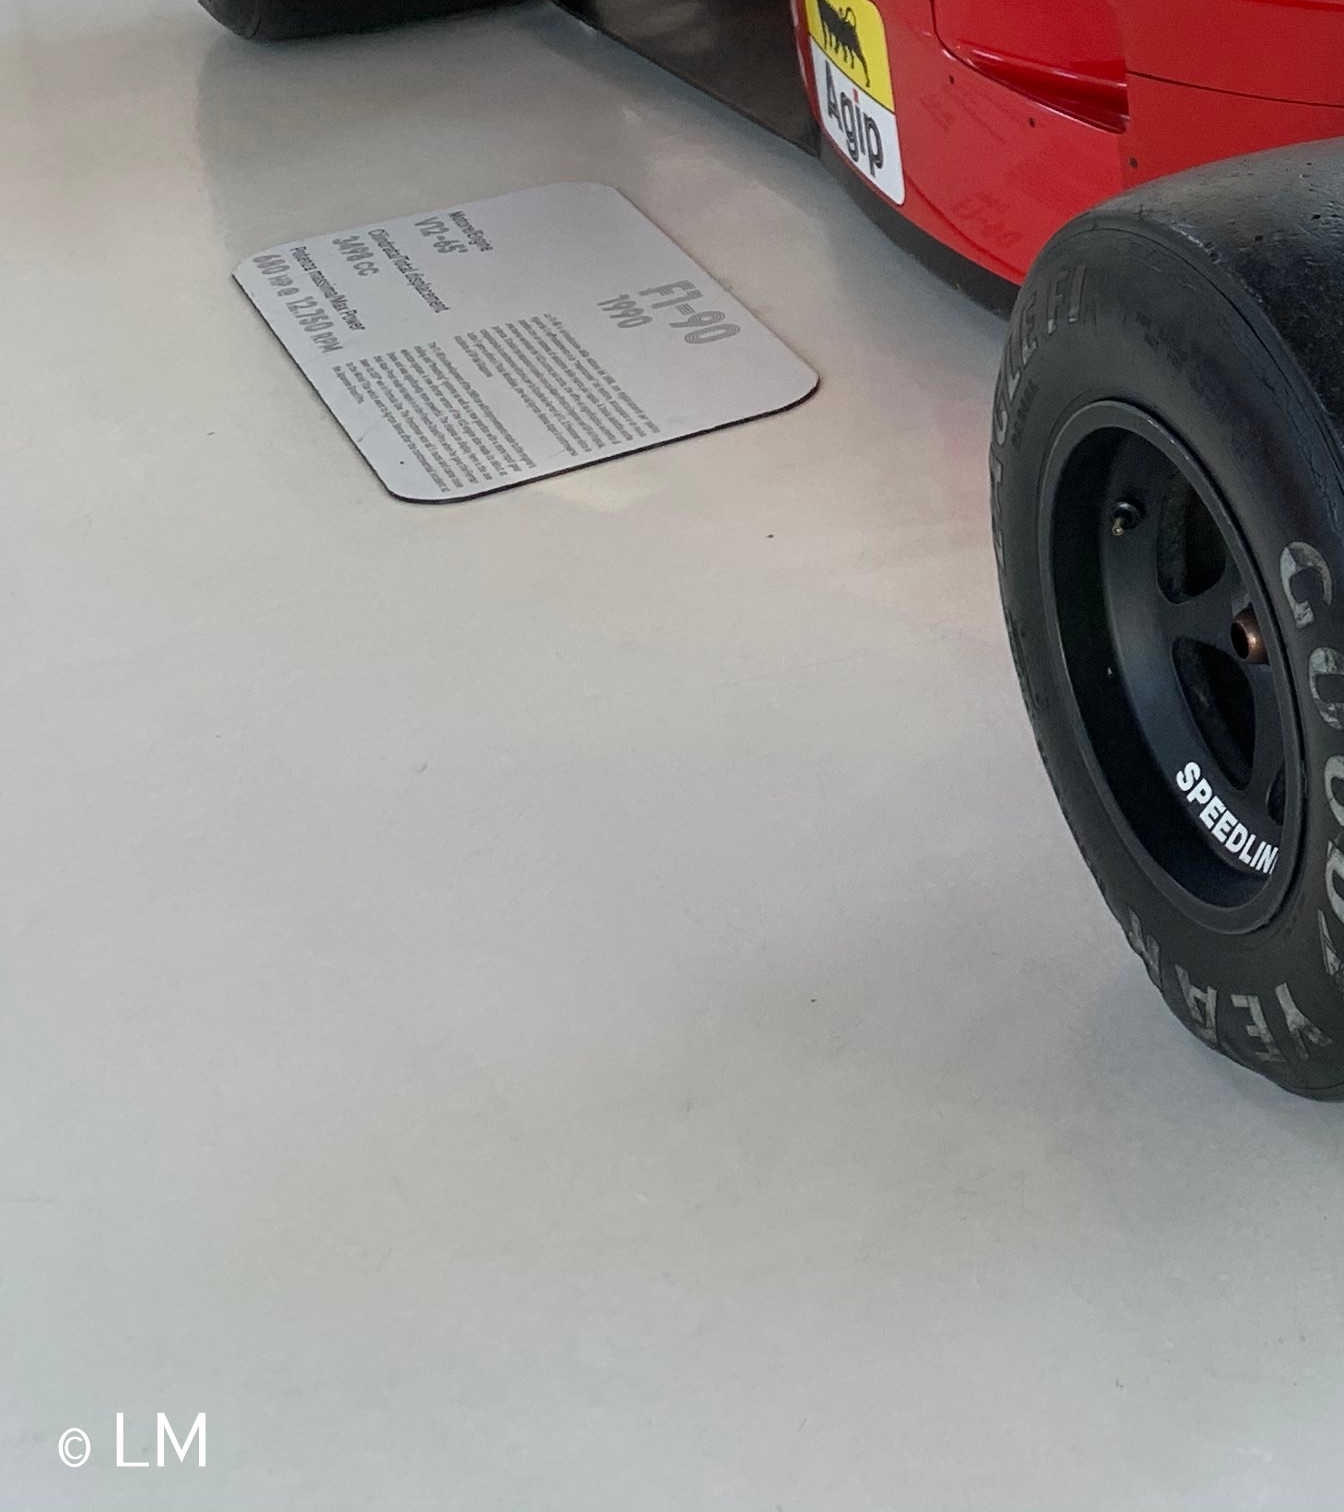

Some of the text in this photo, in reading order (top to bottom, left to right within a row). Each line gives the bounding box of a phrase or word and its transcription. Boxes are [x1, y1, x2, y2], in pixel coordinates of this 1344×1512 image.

[825, 59, 884, 178] Agip
[597, 294, 653, 329] 1990
[638, 279, 741, 345] F1-90
